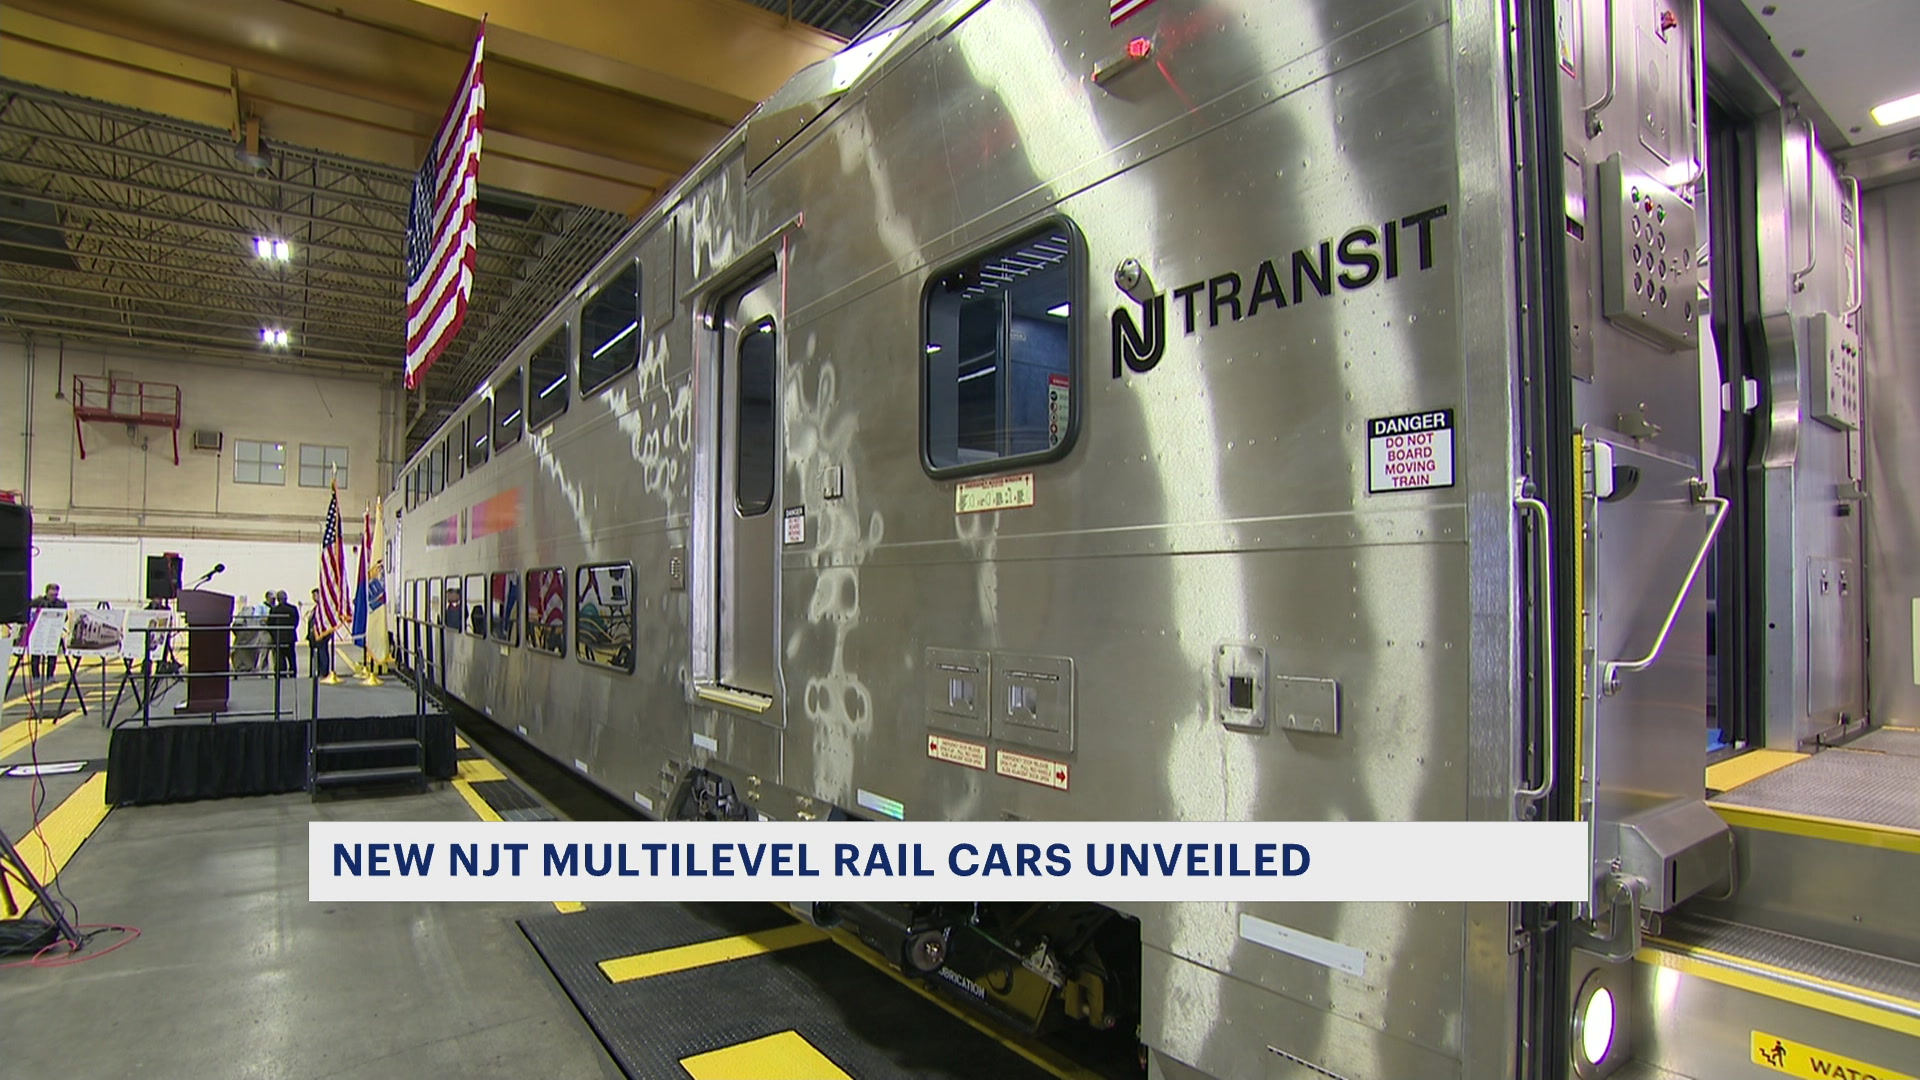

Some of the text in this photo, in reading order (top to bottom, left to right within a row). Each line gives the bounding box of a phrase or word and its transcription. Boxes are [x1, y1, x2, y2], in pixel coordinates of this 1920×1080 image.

[1112, 204, 1448, 379] NJ TRANSIT
[1375, 412, 1446, 436] DANGER
[1386, 432, 1434, 449] DO NOT
[1387, 446, 1433, 462] BOARD
[1385, 459, 1436, 475] MOVING
[1392, 474, 1430, 488] TRAIN
[1810, 1057, 1884, 1080] WAT
